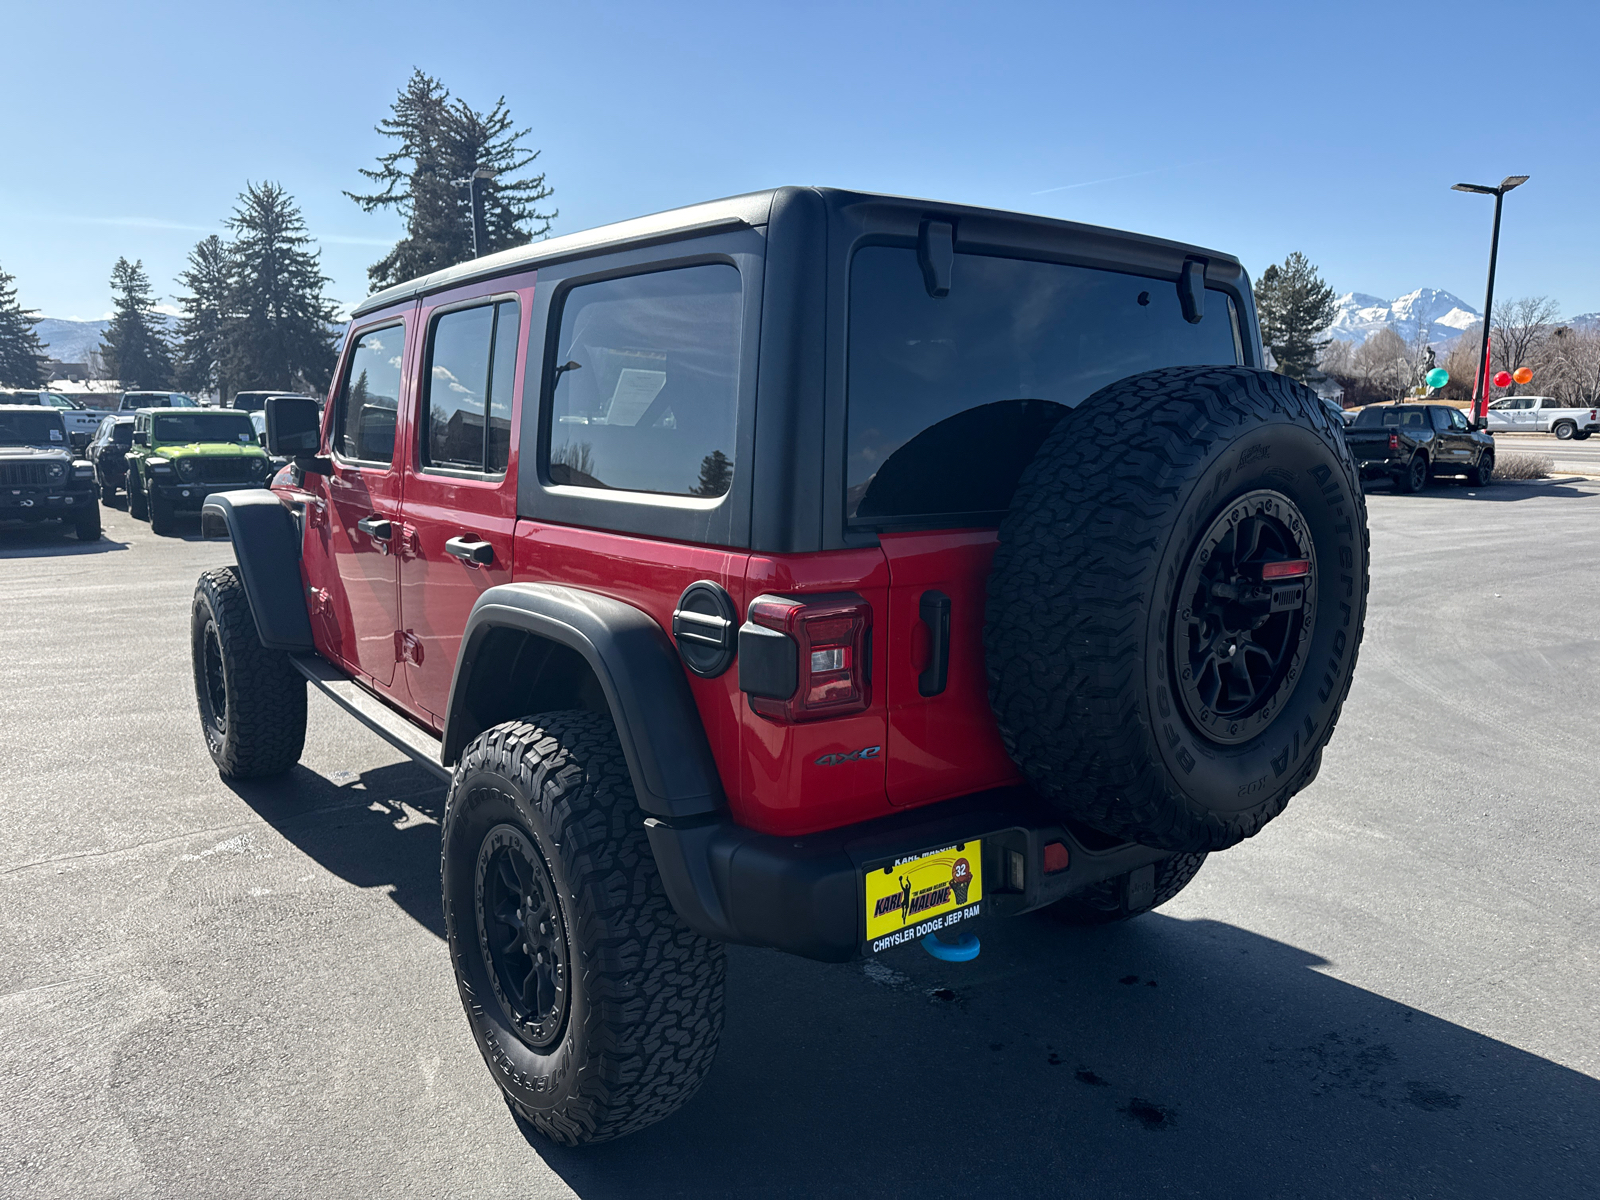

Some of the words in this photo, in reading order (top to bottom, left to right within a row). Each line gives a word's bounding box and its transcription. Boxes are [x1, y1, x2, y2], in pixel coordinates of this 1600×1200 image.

[1306, 463, 1354, 705] All-Terrain
[1270, 714, 1319, 778] T/A
[955, 863, 967, 878] 32
[873, 891, 904, 919] KARL
[907, 886, 952, 917] MALONE
[873, 928, 915, 953] CHRYSLER
[916, 917, 943, 937] DODGE
[944, 911, 963, 927] JEEP
[963, 904, 980, 920] RAM
